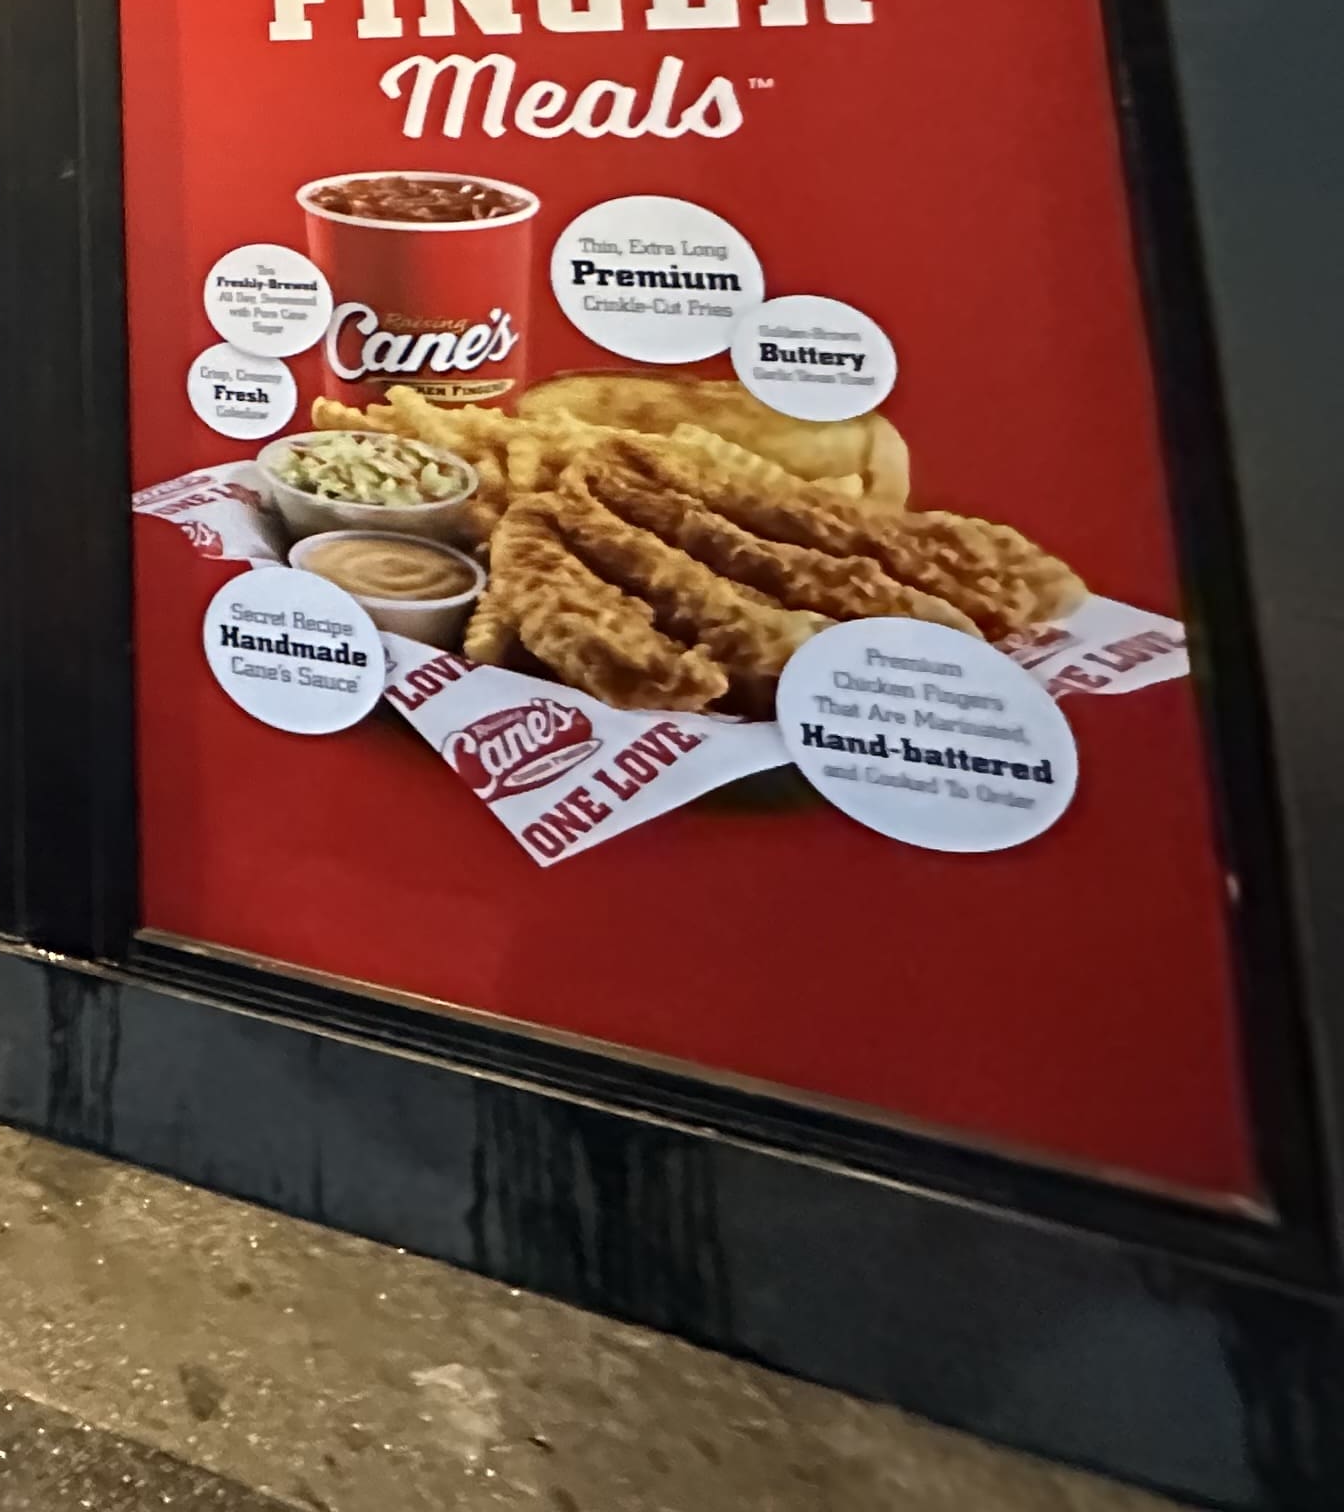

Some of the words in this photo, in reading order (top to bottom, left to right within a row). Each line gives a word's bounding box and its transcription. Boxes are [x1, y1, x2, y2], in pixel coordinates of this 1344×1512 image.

[629, 239, 676, 257] Extra
[681, 240, 729, 261] Long
[571, 260, 742, 291] Premium
[326, 302, 519, 380] Cane's
[758, 342, 866, 372] Buttery
[213, 384, 270, 403] Fresh
[230, 603, 286, 626] Secret
[293, 611, 353, 638] Recipe
[219, 624, 368, 667] Handmade
[231, 656, 291, 683] Cane's
[800, 723, 1054, 784] Hand-battered
[522, 787, 614, 858] ONE
[593, 721, 702, 801] LOVE
